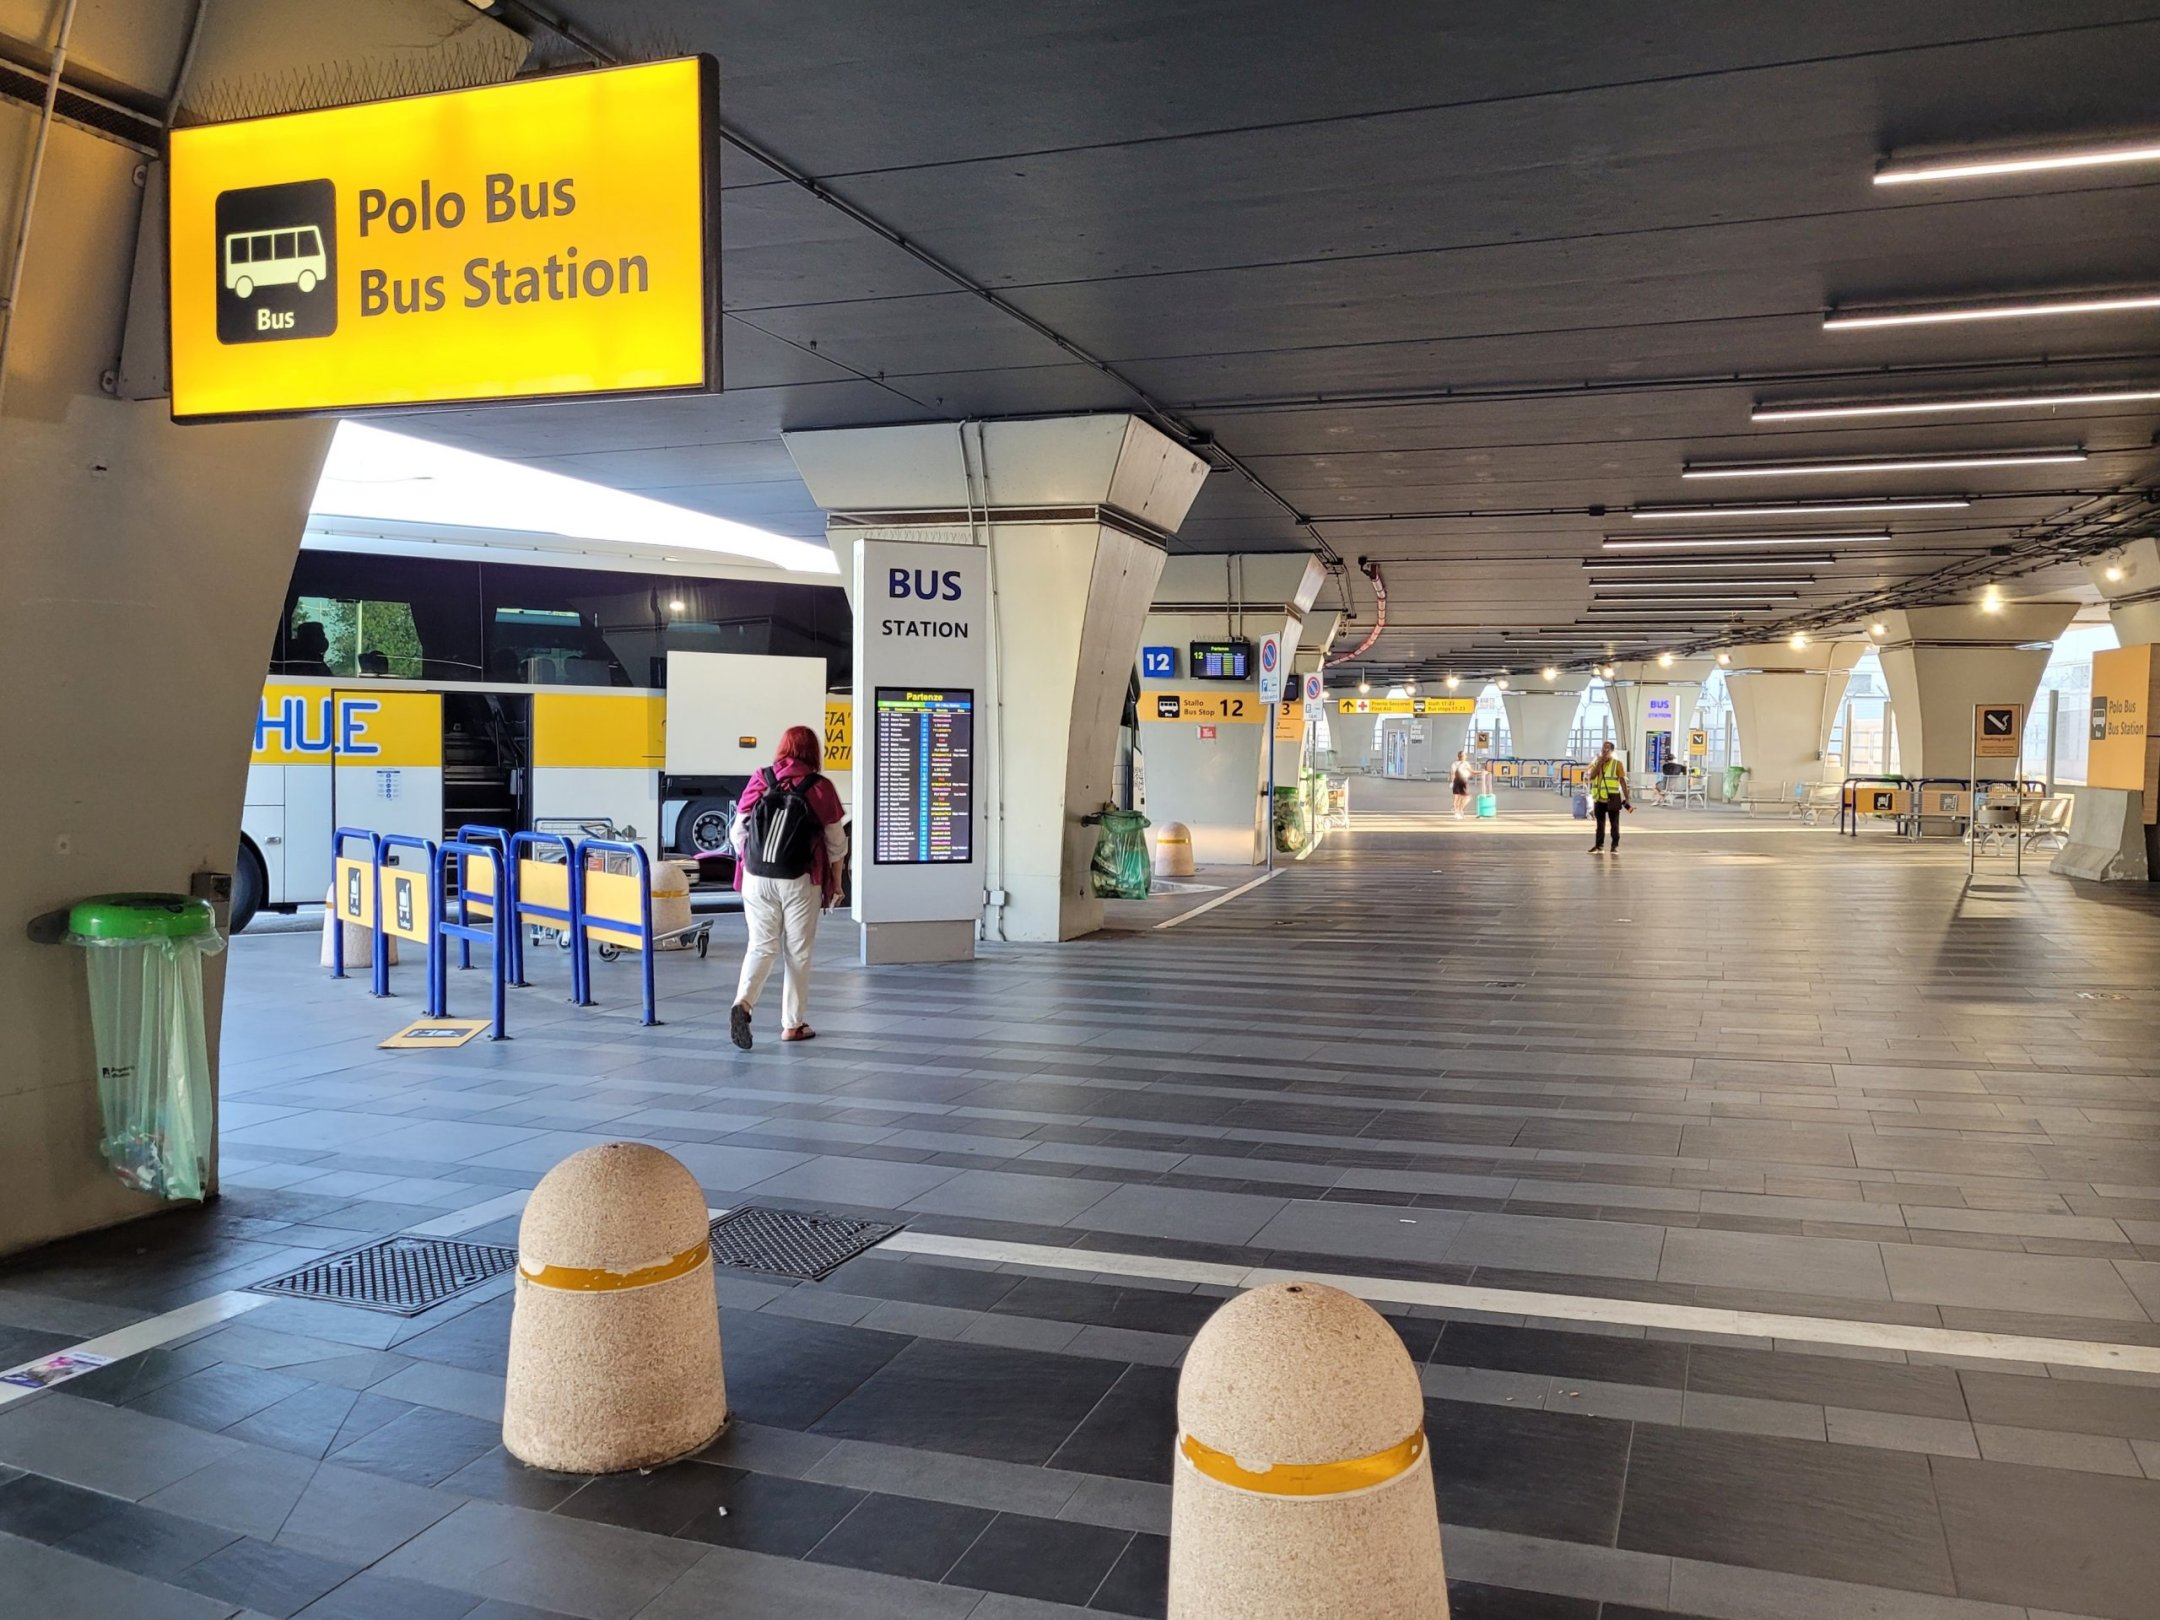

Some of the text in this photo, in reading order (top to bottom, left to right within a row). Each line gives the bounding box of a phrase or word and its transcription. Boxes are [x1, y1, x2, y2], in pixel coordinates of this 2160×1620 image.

[359, 172, 577, 237] Polo Bus
[360, 246, 649, 317] Bus Station
[256, 307, 296, 331] Bus
[888, 567, 962, 601] BUS
[881, 619, 970, 639] STATION
[1146, 653, 1171, 671] 12
[1193, 651, 1204, 660] 12
[906, 692, 944, 702] Partenze
[1183, 699, 1205, 708] Stallo
[1650, 700, 1669, 709] BUS
[1183, 708, 1216, 718] Bus Stop
[1219, 699, 1244, 717] 12
[2109, 699, 2137, 714] Polo Bus
[2108, 722, 2119, 735] Bus
[2120, 721, 2144, 735] Station
